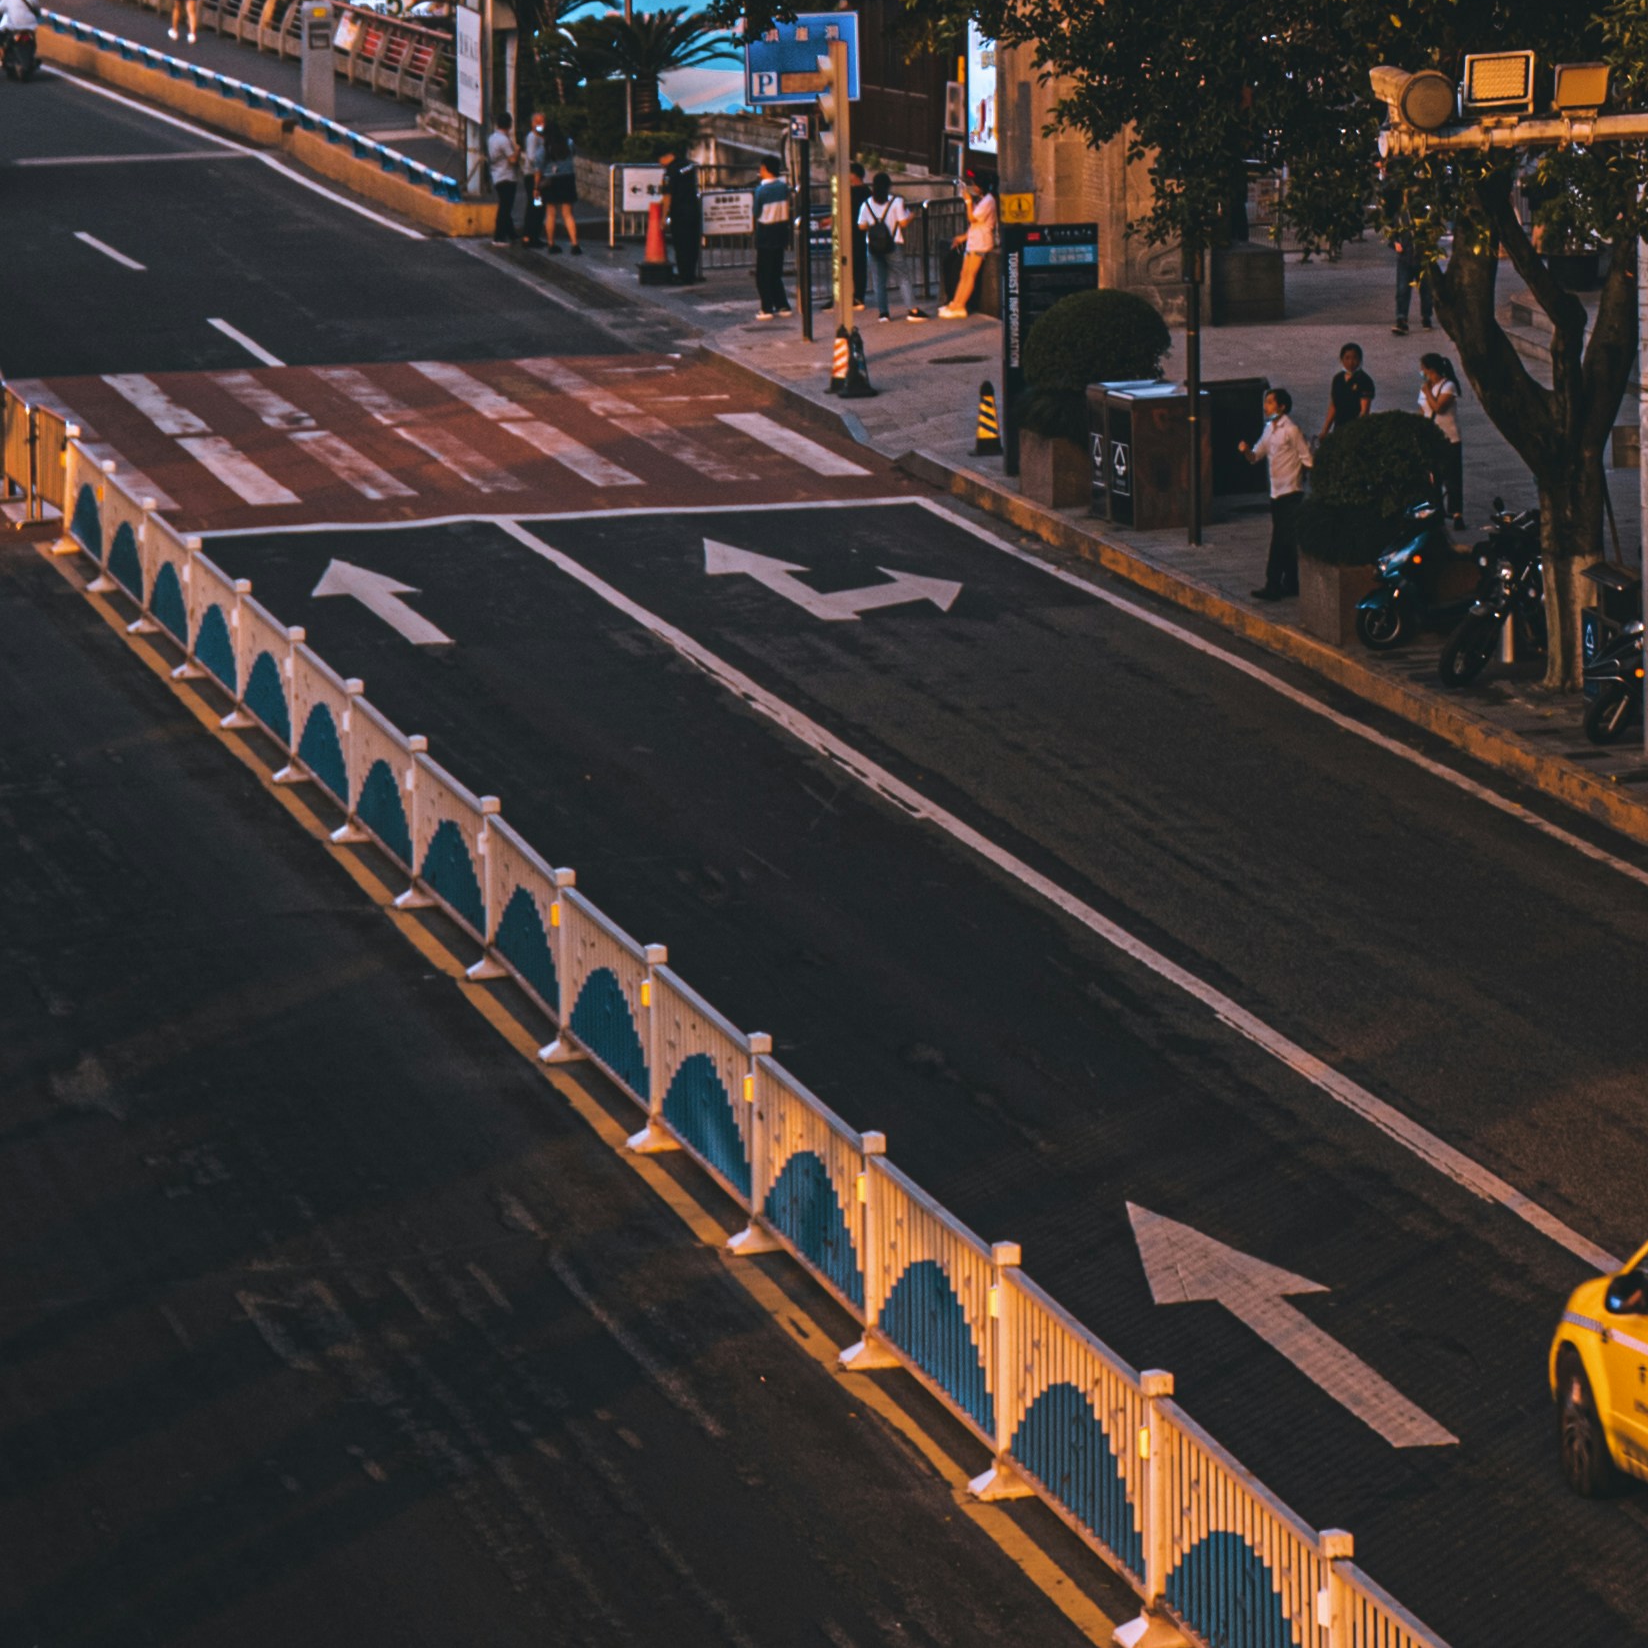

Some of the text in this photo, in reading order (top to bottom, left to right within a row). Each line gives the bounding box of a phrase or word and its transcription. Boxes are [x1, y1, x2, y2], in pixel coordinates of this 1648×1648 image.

[759, 73, 774, 95] P
[1008, 251, 1020, 368] TOURIST INFORMATION
